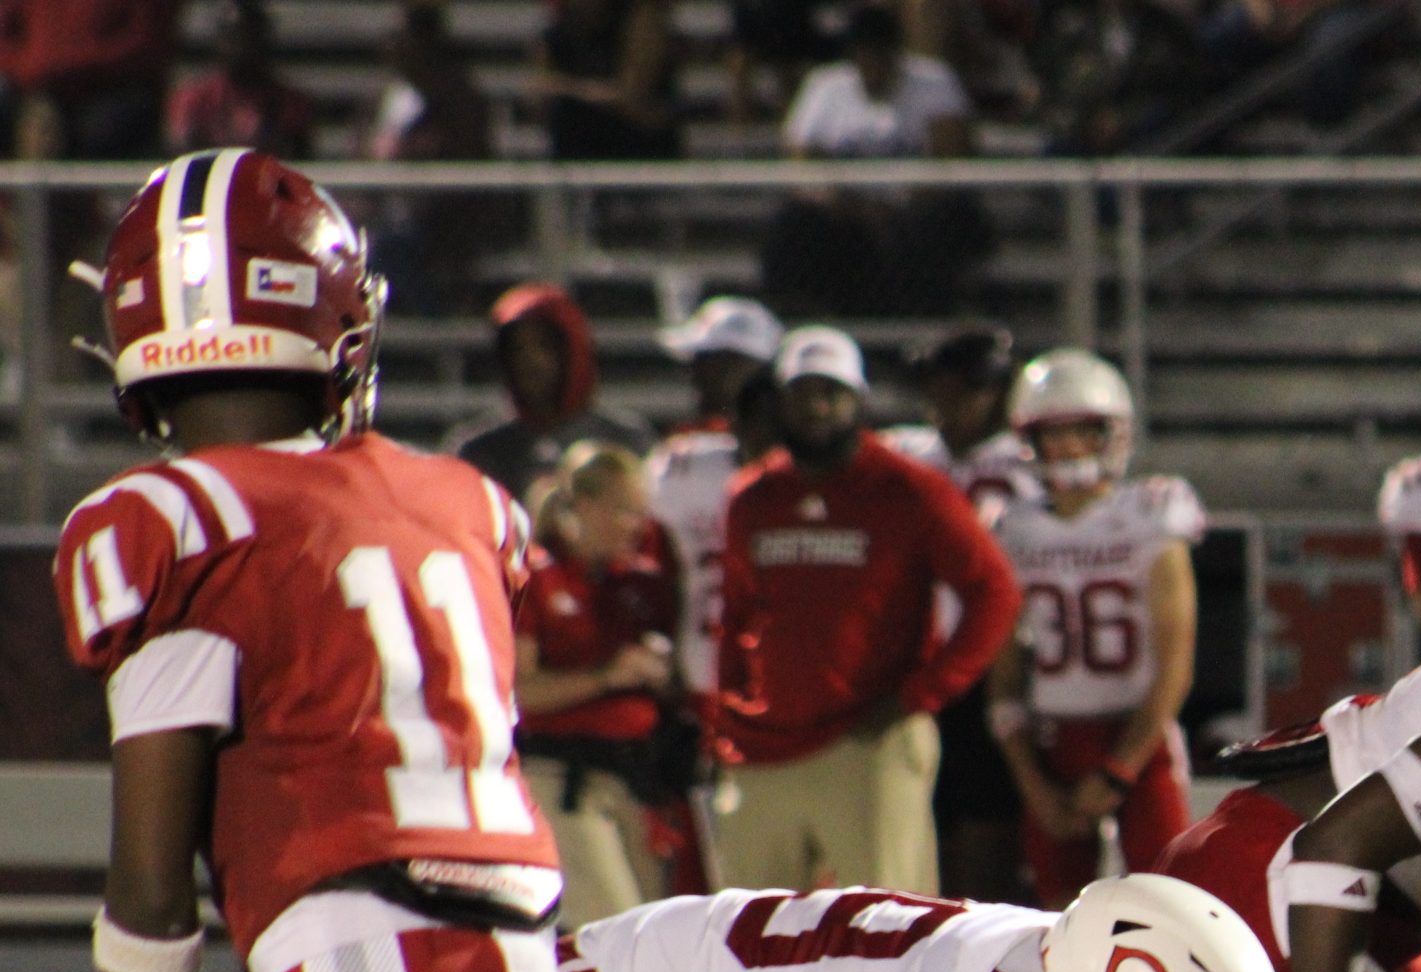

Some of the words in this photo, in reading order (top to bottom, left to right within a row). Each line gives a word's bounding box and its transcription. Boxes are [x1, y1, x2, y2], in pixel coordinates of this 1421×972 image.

[141, 335, 272, 368] Riddell
[1026, 581, 1137, 676] 36
[336, 545, 535, 834] 11
